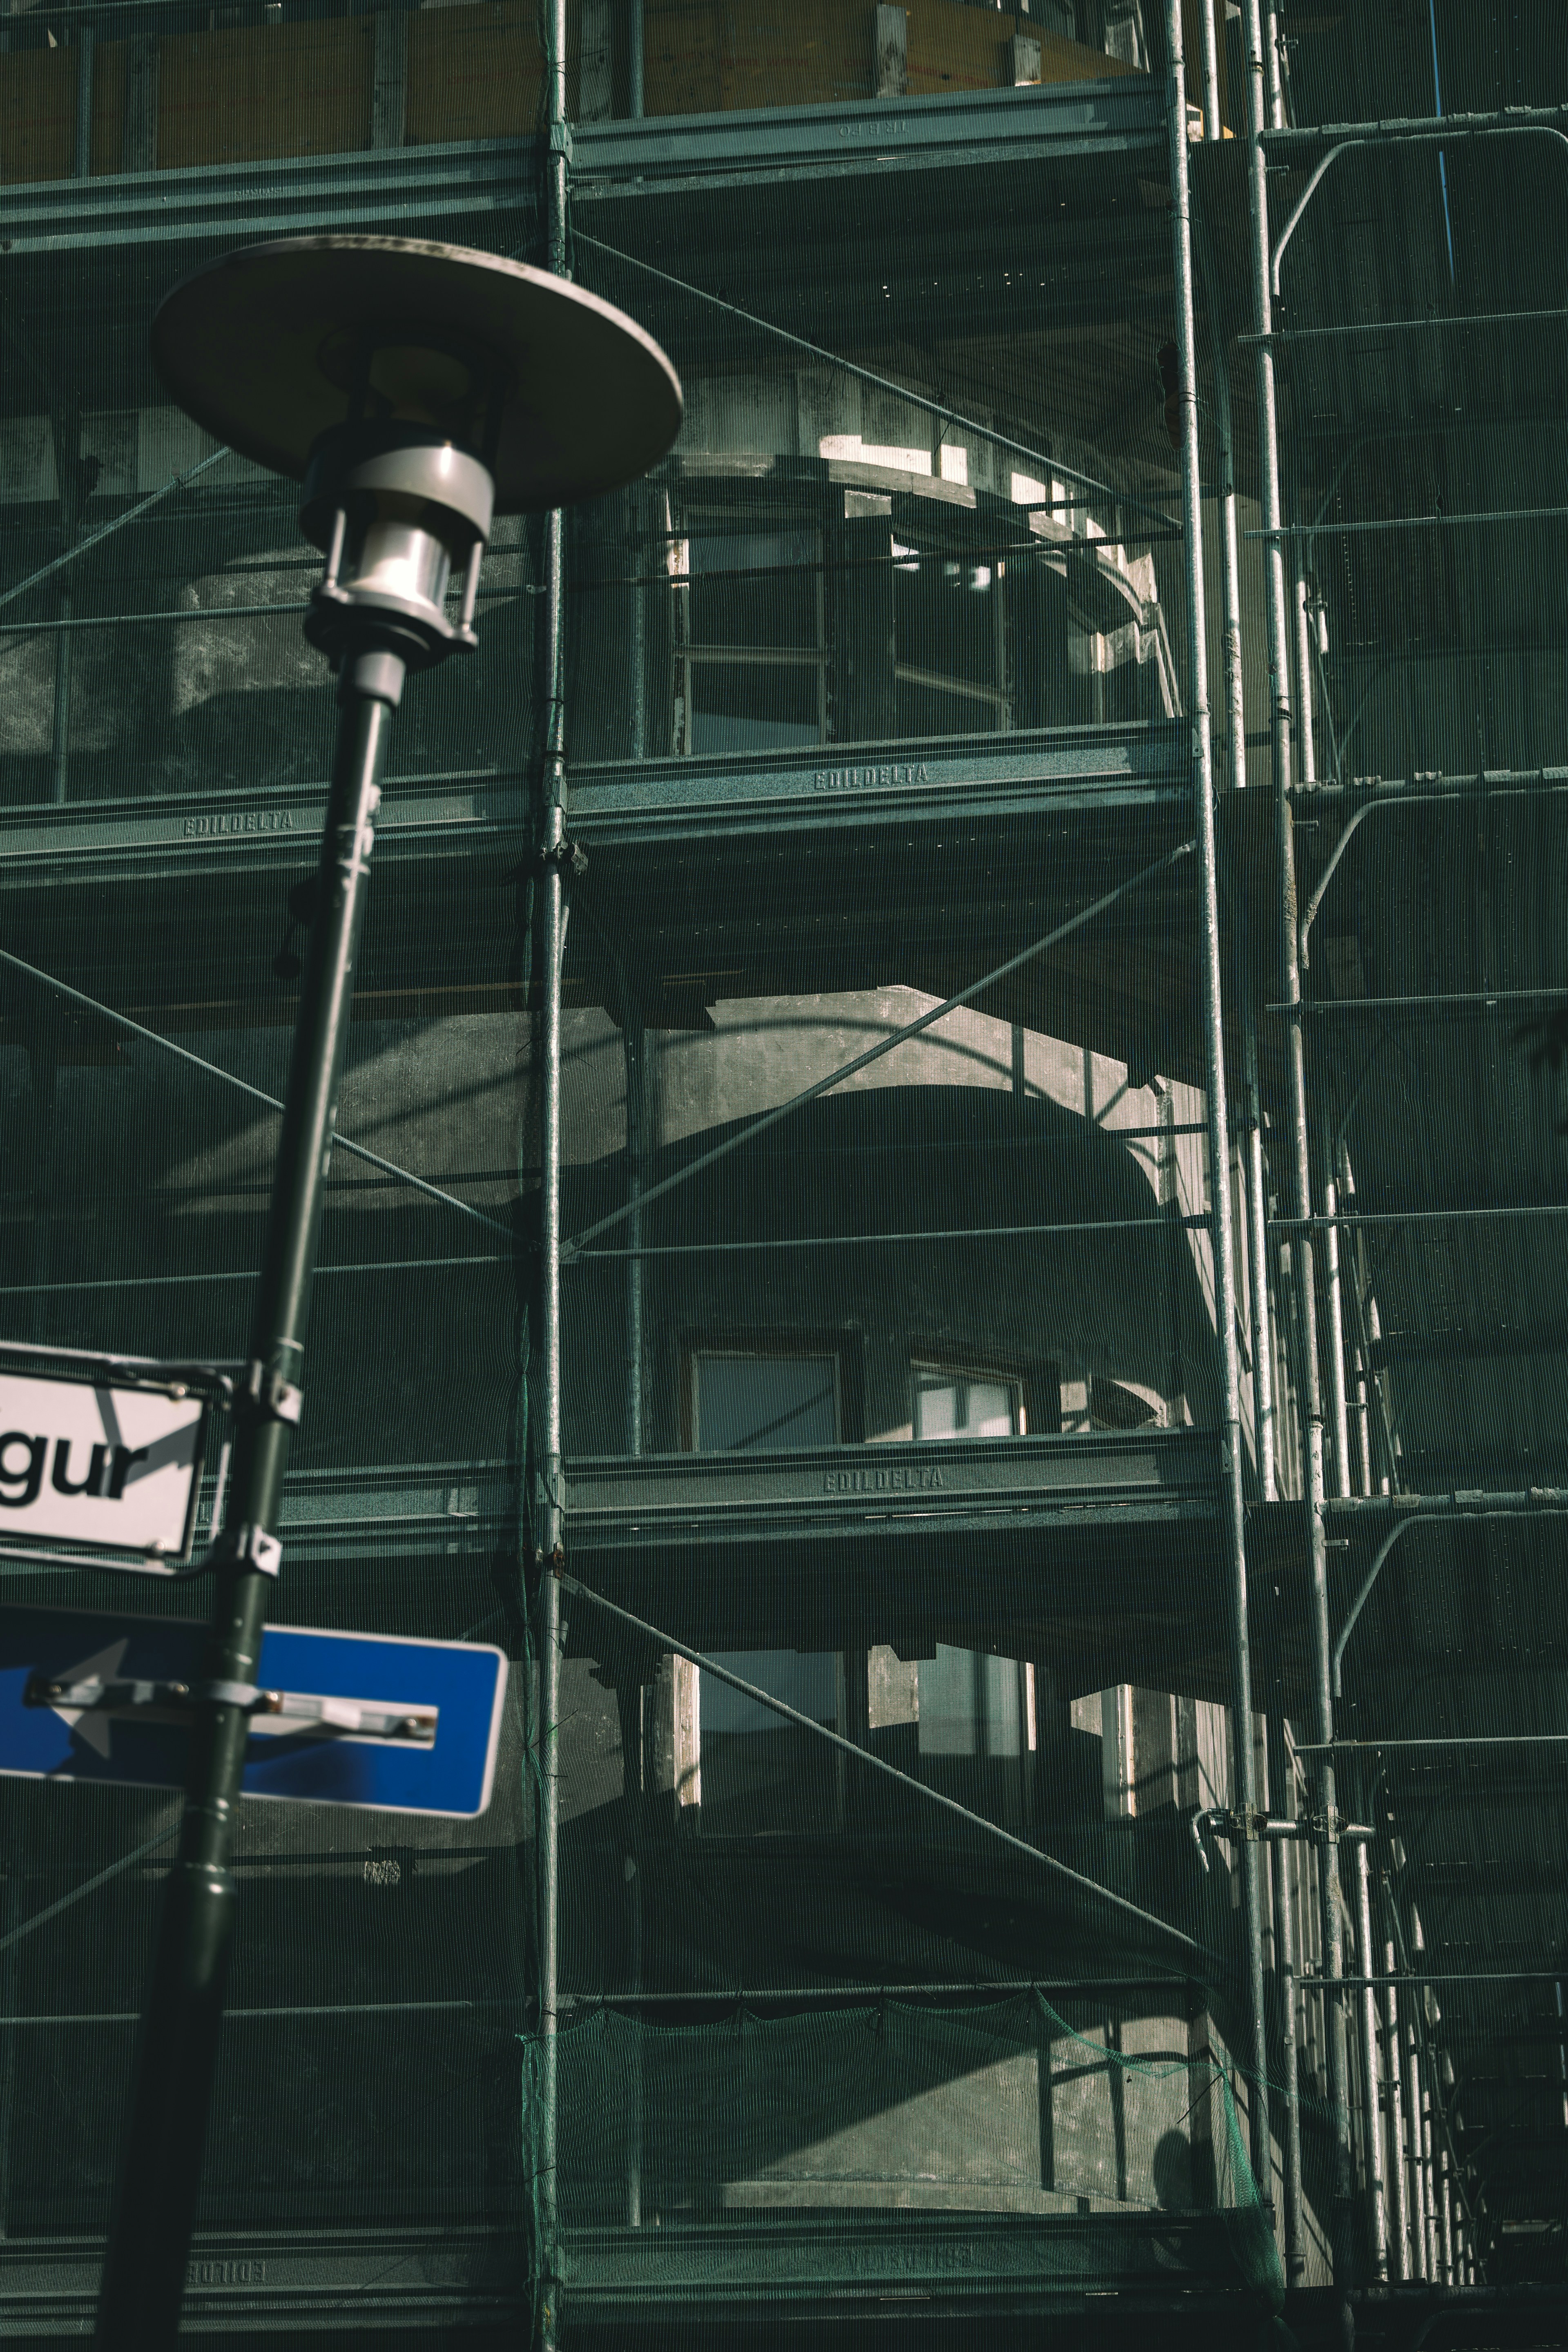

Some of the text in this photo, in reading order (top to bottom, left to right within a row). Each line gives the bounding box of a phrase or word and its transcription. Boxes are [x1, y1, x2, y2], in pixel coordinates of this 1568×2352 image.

[814, 763, 928, 790] EDILDELTA
[185, 810, 292, 836] EDILDELTA
[0, 1431, 149, 1507] gur
[824, 1466, 943, 1493] EDILDELTA
[187, 2261, 265, 2284] EDILDE
